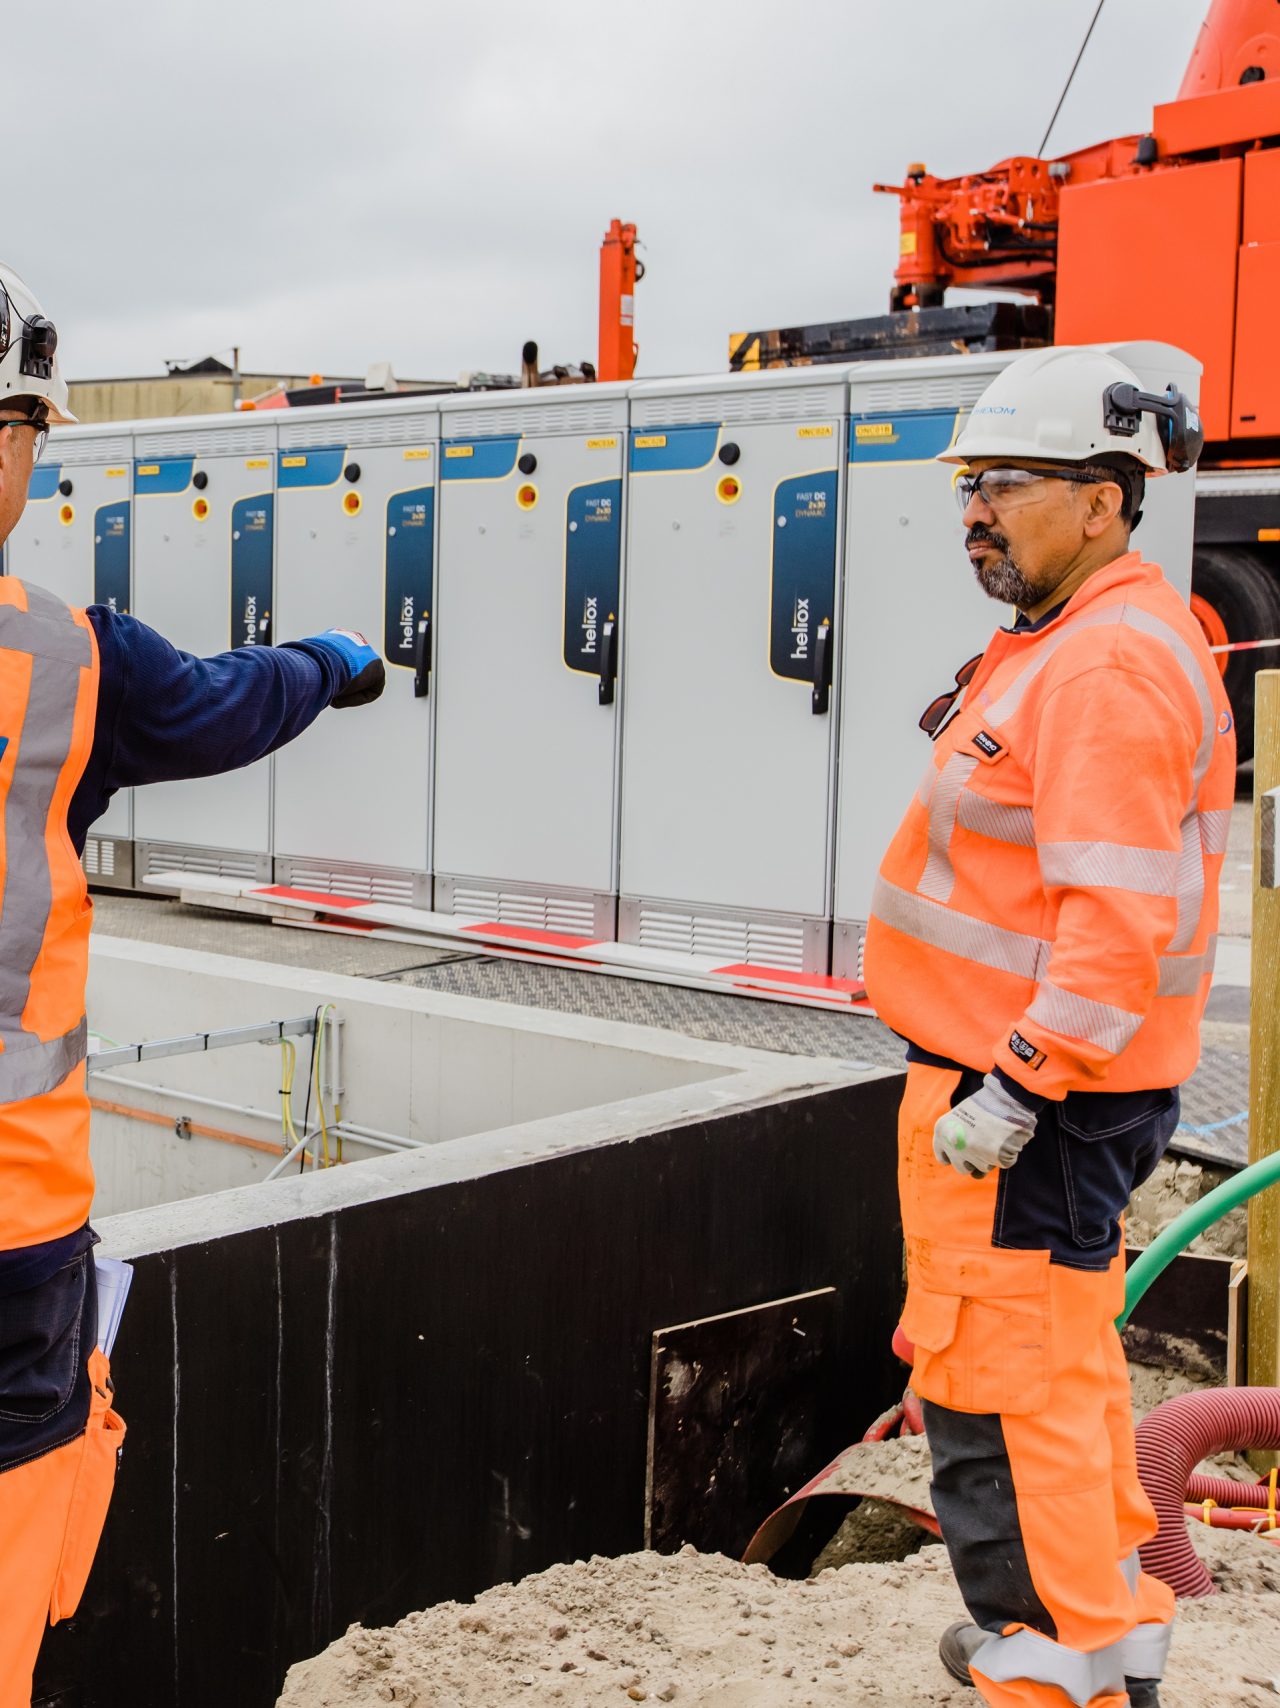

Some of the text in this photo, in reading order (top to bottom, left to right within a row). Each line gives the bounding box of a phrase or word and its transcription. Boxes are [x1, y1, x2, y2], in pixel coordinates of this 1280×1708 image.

[601, 498, 612, 507] DC
[796, 491, 826, 501] FAST DC
[244, 596, 256, 645] heliox
[399, 596, 413, 649] heliox
[581, 597, 597, 653] heliox
[790, 598, 809, 659] heliox
